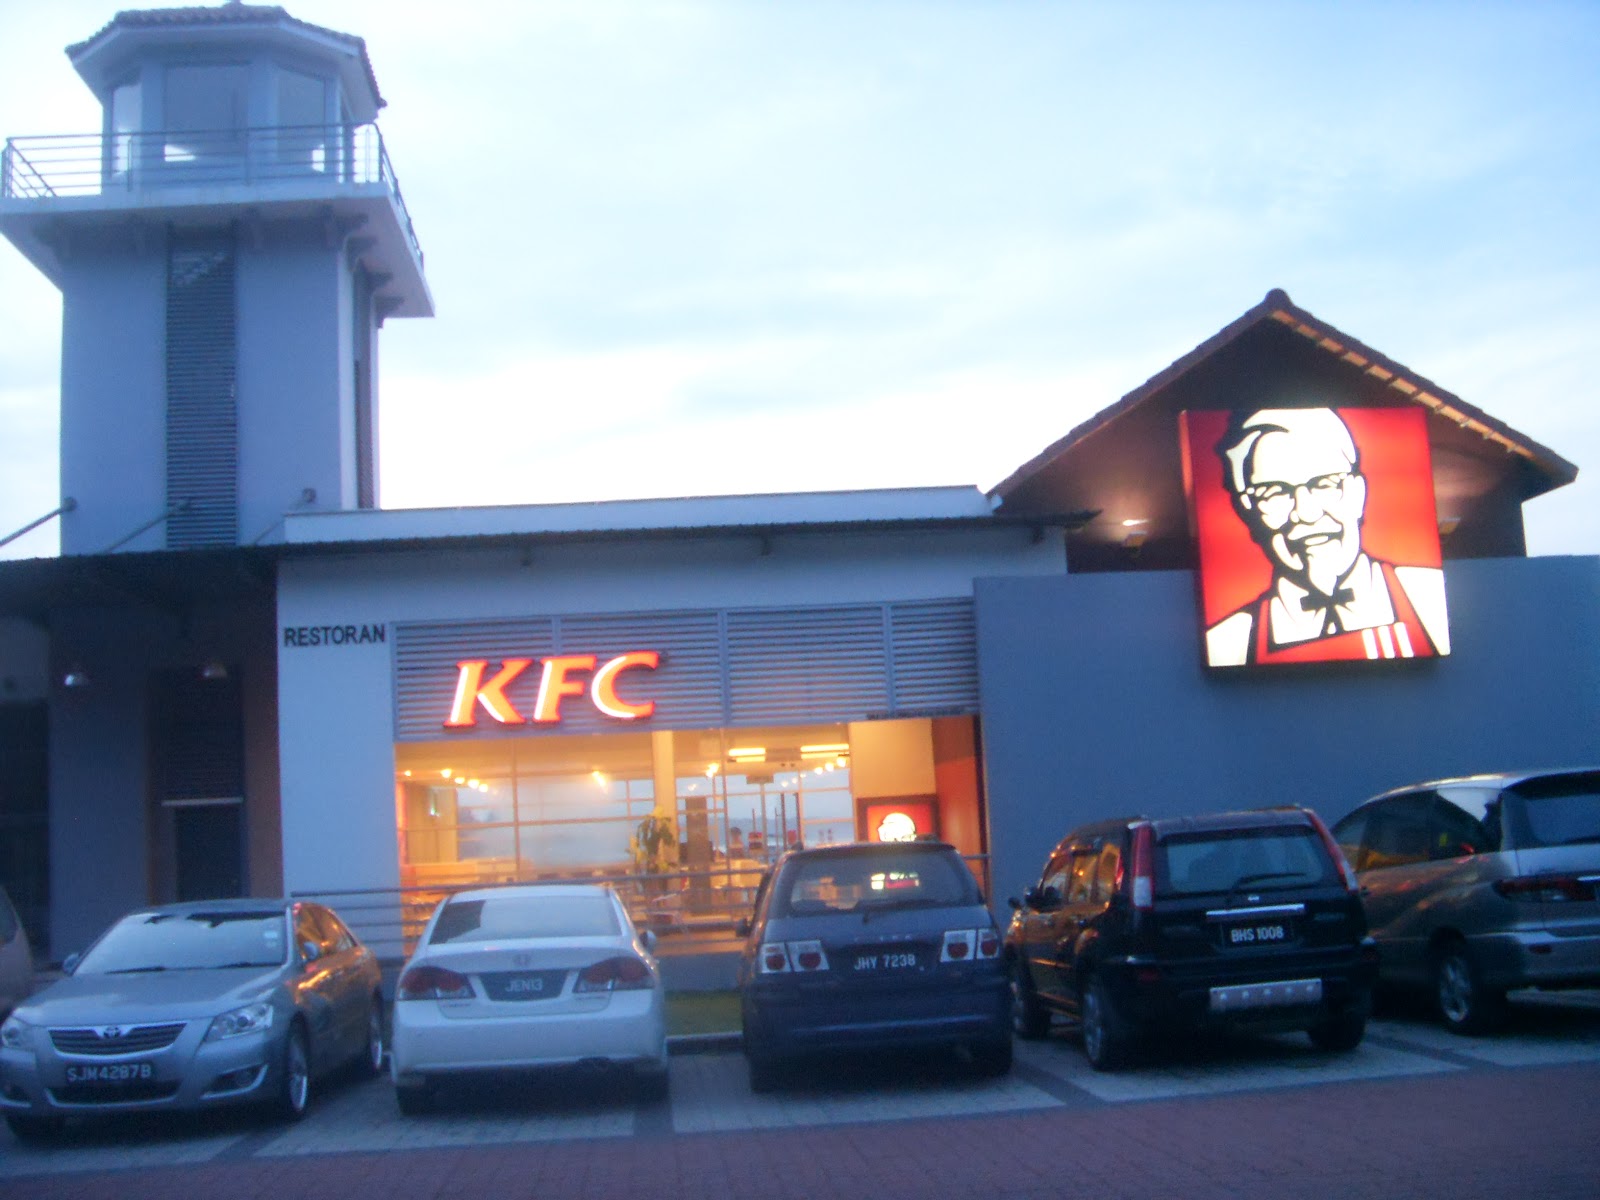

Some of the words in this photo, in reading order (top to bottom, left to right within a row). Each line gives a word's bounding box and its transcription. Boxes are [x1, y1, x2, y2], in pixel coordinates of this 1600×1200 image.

[284, 624, 385, 647] RESTORAN
[443, 650, 660, 727] KFC
[1231, 927, 1254, 943] BHS
[1256, 925, 1284, 940] 1008
[854, 955, 877, 970] JHY
[883, 953, 916, 968] 7238
